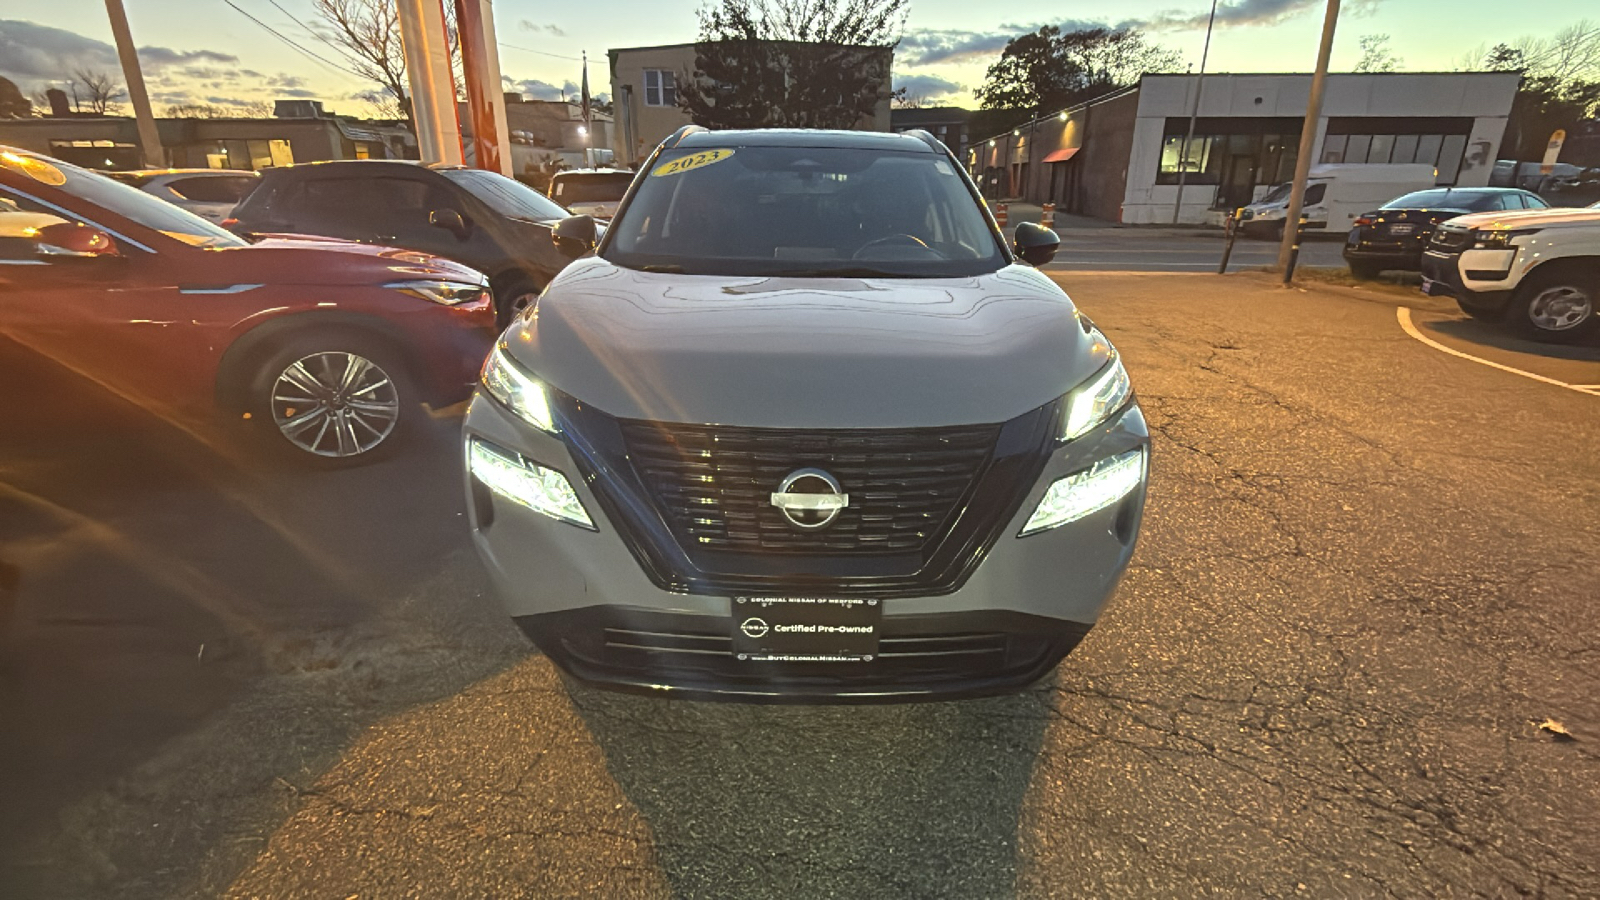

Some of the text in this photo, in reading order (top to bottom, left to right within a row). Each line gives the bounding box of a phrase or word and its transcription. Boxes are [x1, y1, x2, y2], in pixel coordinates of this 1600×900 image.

[667, 151, 720, 174] 2023
[774, 624, 873, 633] Certified Pre-Owned
